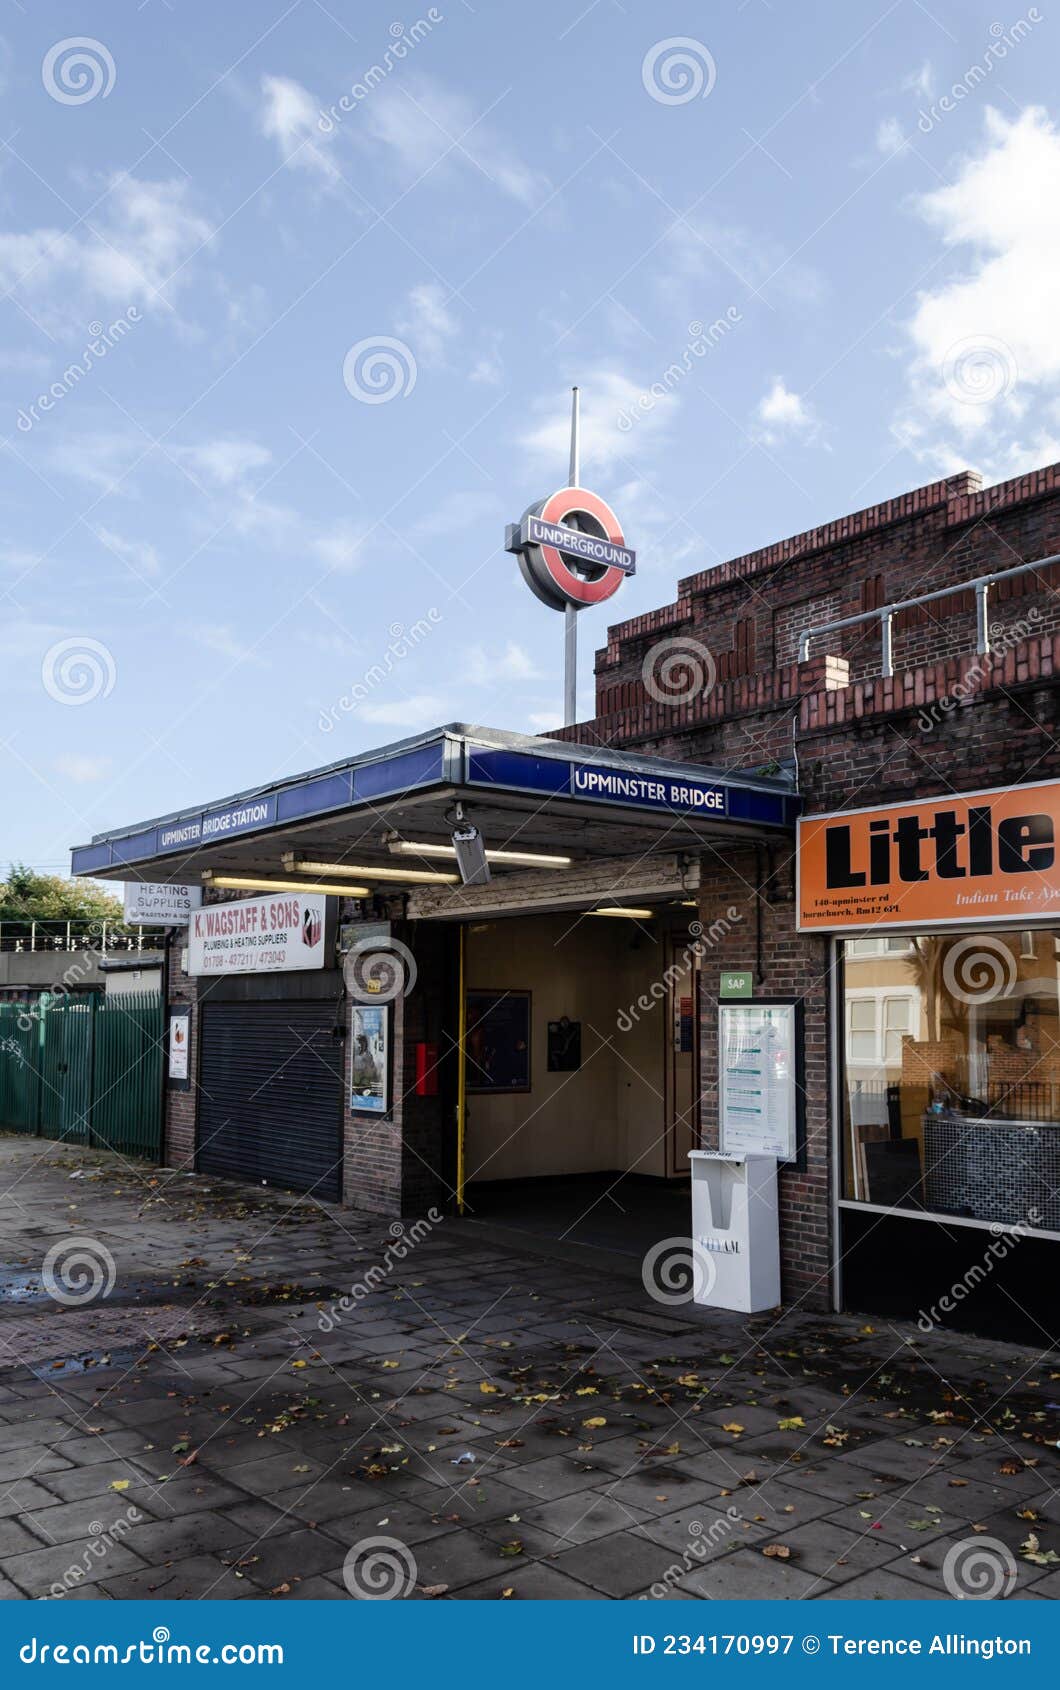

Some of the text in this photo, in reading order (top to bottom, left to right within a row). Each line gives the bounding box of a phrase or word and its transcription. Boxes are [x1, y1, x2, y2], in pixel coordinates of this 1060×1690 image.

[534, 523, 632, 566] UNDERGROUND
[575, 771, 724, 810] UPMINSTER BRIDGE
[162, 804, 268, 846] UPMINSTER BRIDGE STATION
[826, 806, 1055, 890] Little
[140, 885, 188, 896] HEATING
[879, 893, 889, 902] rd
[956, 889, 998, 905] Indian
[1003, 886, 1034, 902] Take
[137, 897, 191, 909] SUPPLIES
[195, 900, 300, 938] K. WAGSTAFF & SONS
[204, 939, 229, 951] PLUMBING
[235, 936, 256, 948] HEATING
[258, 933, 288, 946] SUPPLIERS
[204, 955, 223, 968] 01708
[728, 979, 745, 989] SAP
